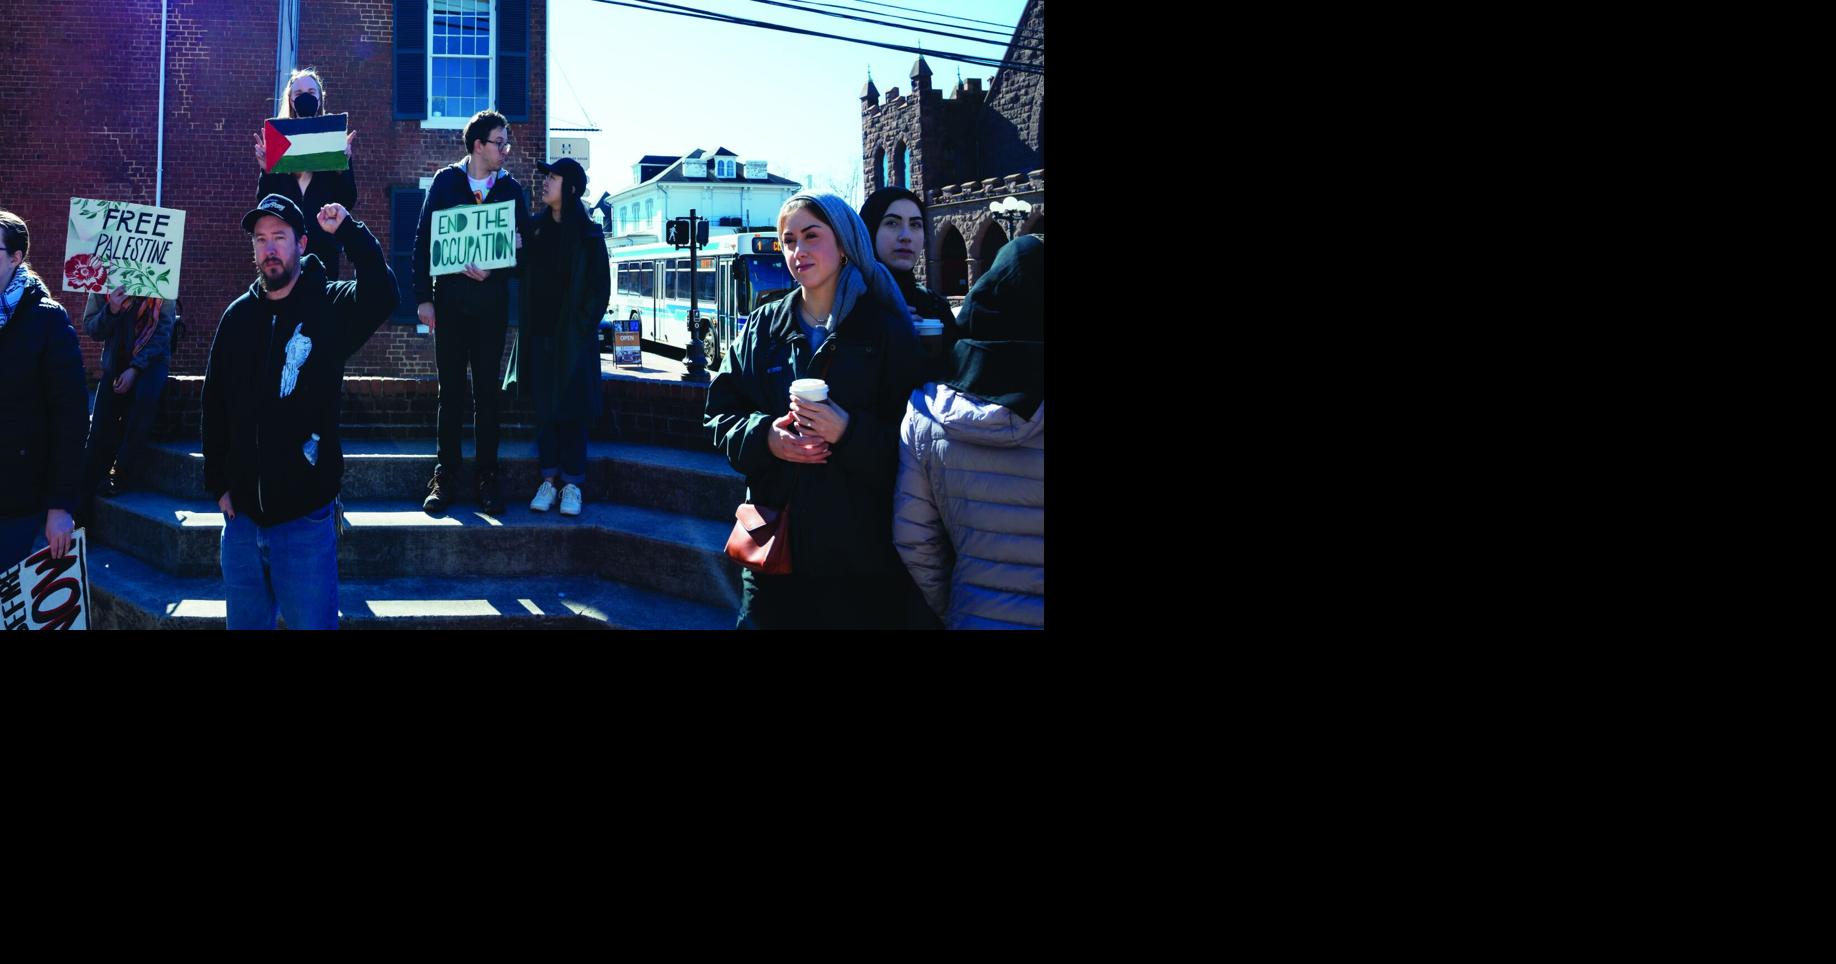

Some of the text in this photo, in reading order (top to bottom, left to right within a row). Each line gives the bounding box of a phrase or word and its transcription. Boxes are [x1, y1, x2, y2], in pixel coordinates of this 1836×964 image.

[103, 208, 170, 237] FREE
[439, 207, 509, 235] END THE
[93, 233, 173, 265] PALESTINE
[432, 230, 514, 267] OCCUPATION
[757, 240, 762, 251] 1
